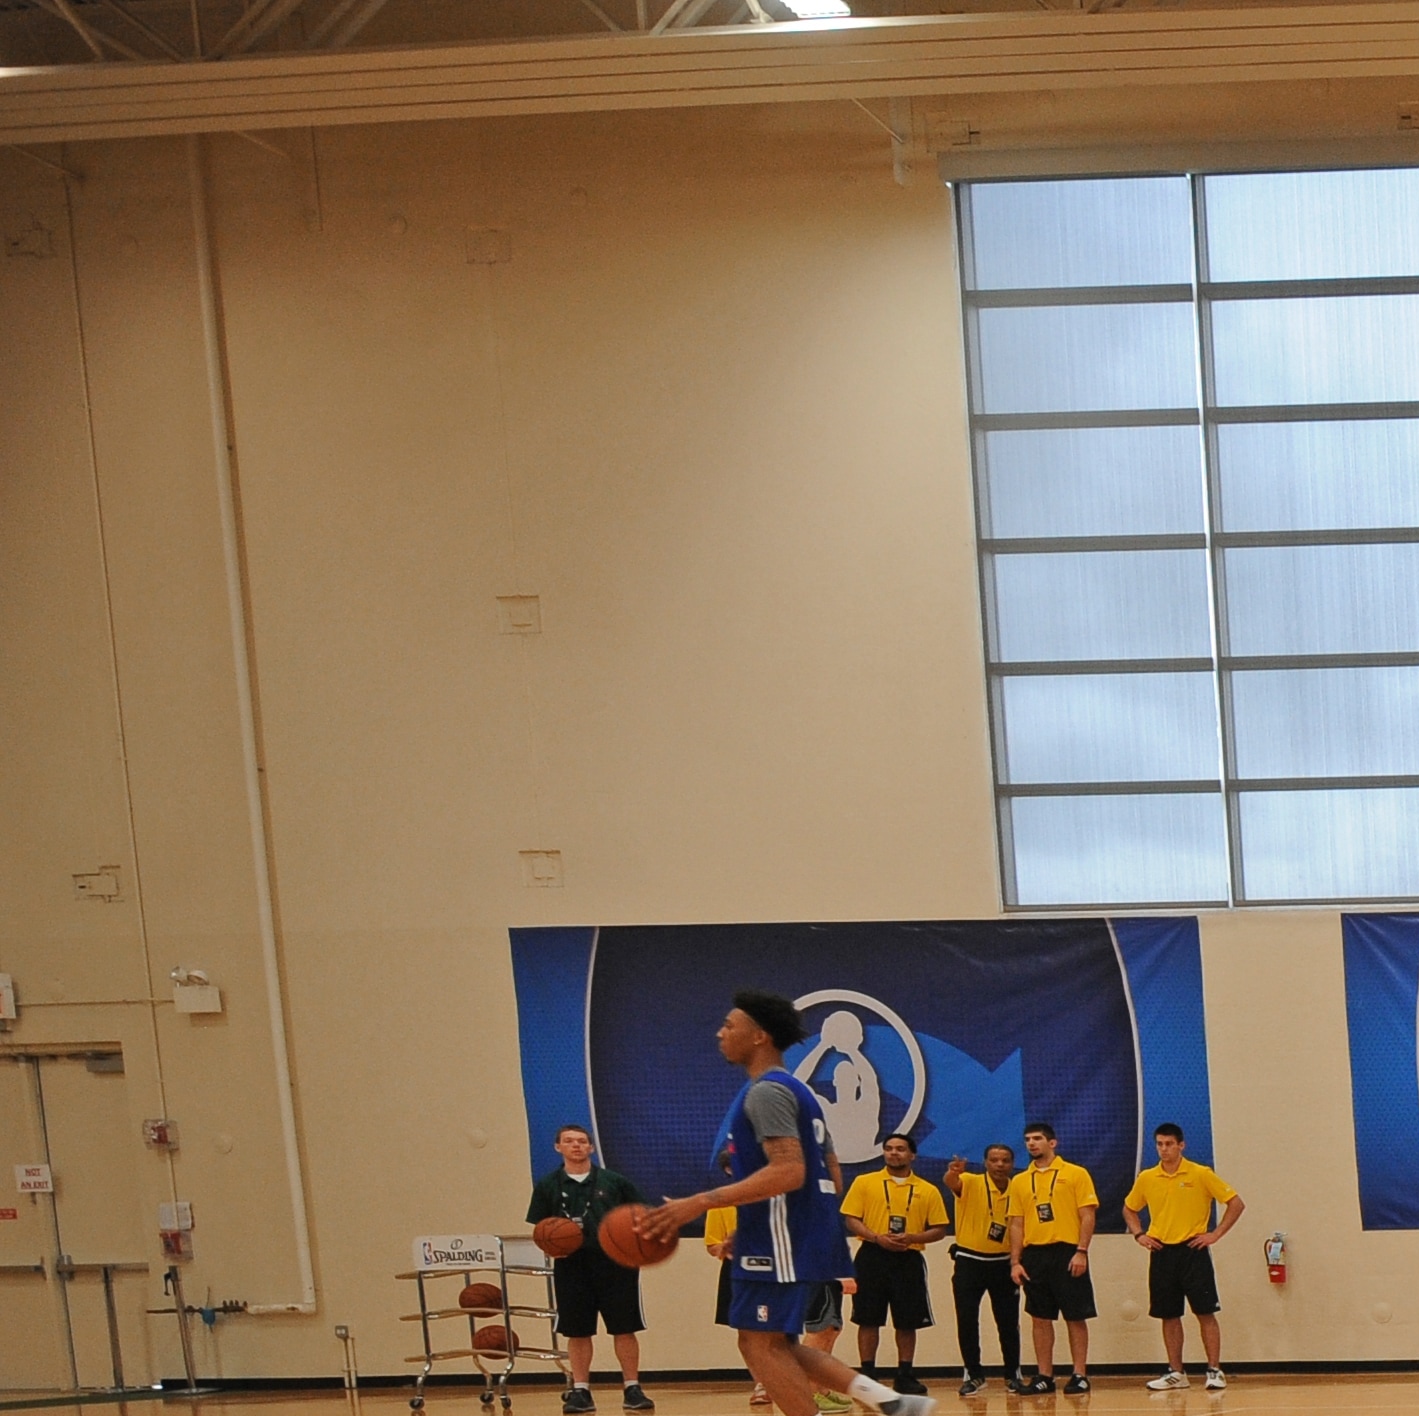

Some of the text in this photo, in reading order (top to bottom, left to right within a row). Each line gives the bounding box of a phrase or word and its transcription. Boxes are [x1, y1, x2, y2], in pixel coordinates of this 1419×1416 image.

[25, 1168, 41, 1177] NOT
[21, 1181, 49, 1190] AN EXIT
[433, 1248, 484, 1264] SPALDING
